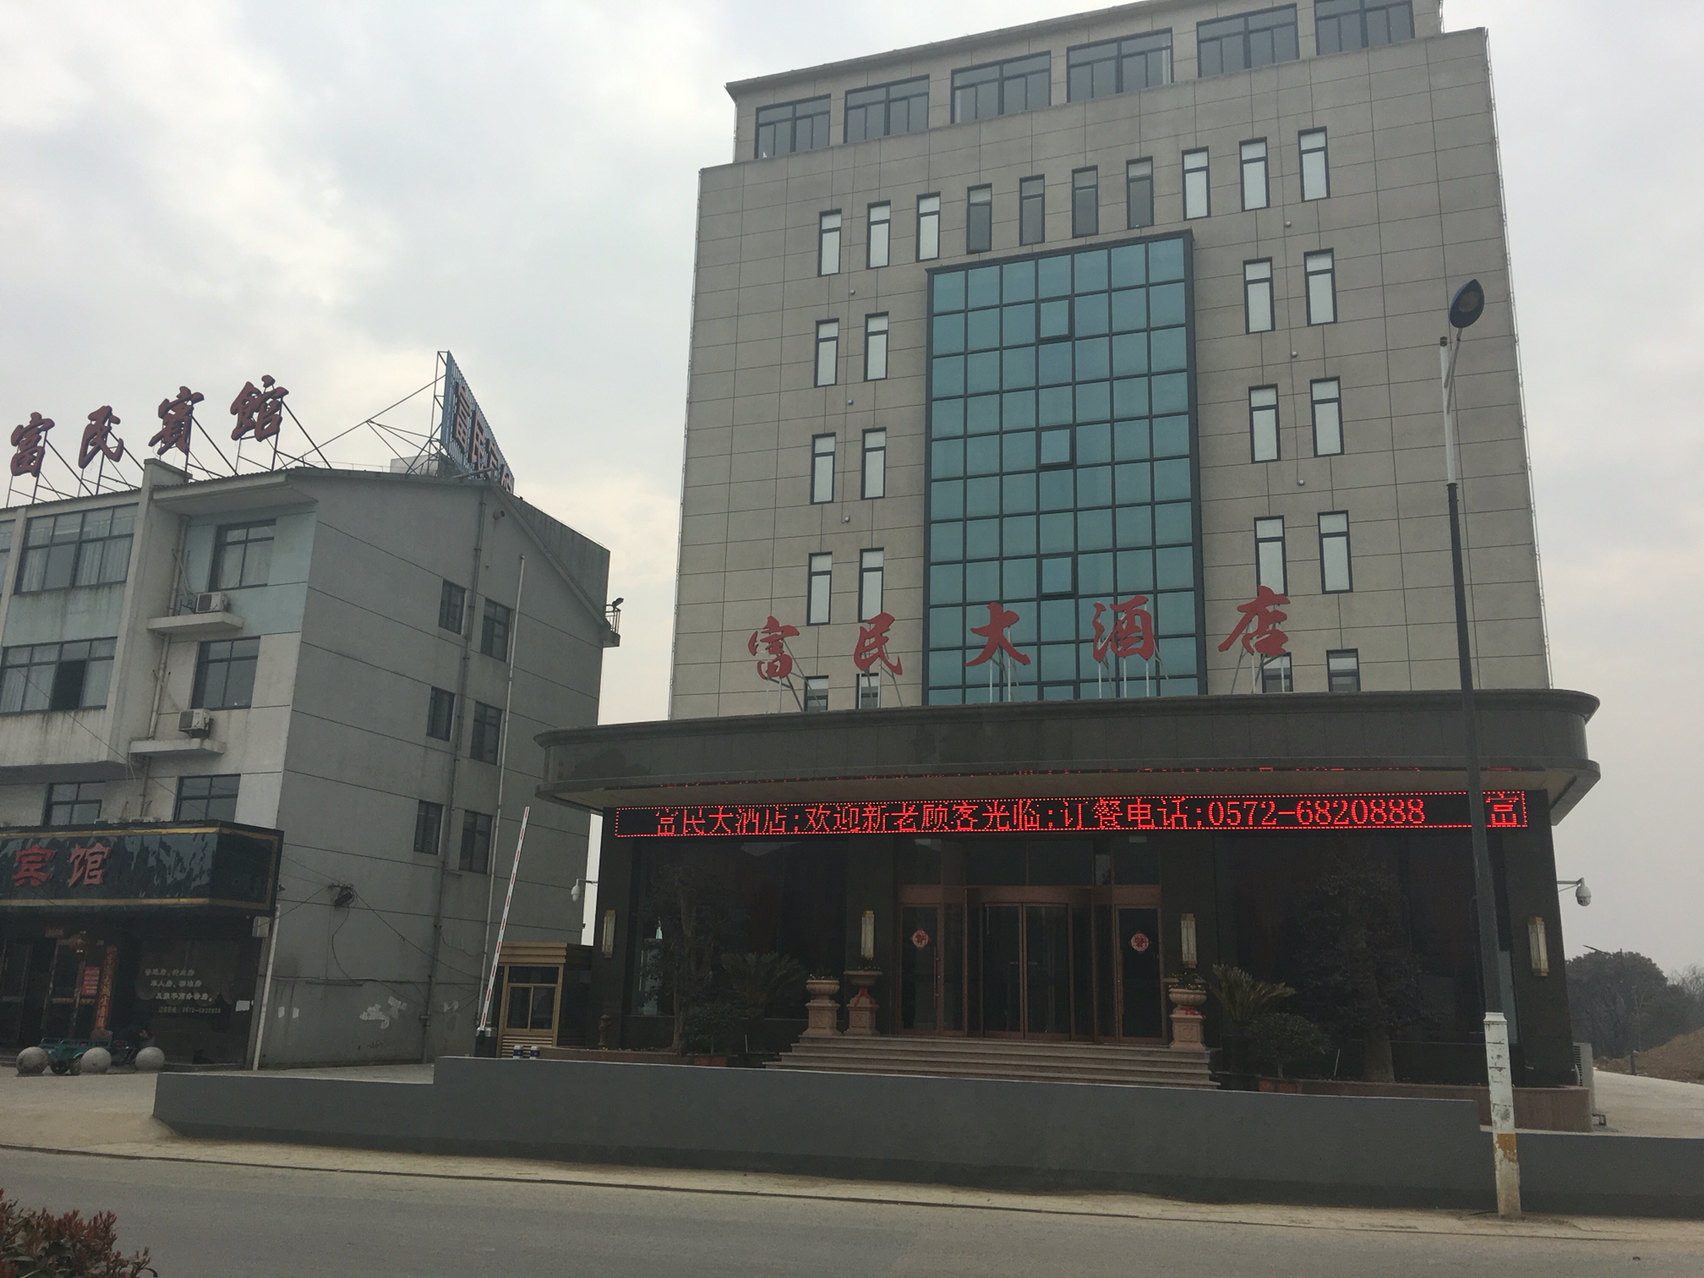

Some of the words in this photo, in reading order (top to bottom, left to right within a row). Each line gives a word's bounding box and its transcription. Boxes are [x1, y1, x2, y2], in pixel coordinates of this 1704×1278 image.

[748, 586, 1289, 678] 富民大酒店
[11, 842, 111, 888] 宾馆
